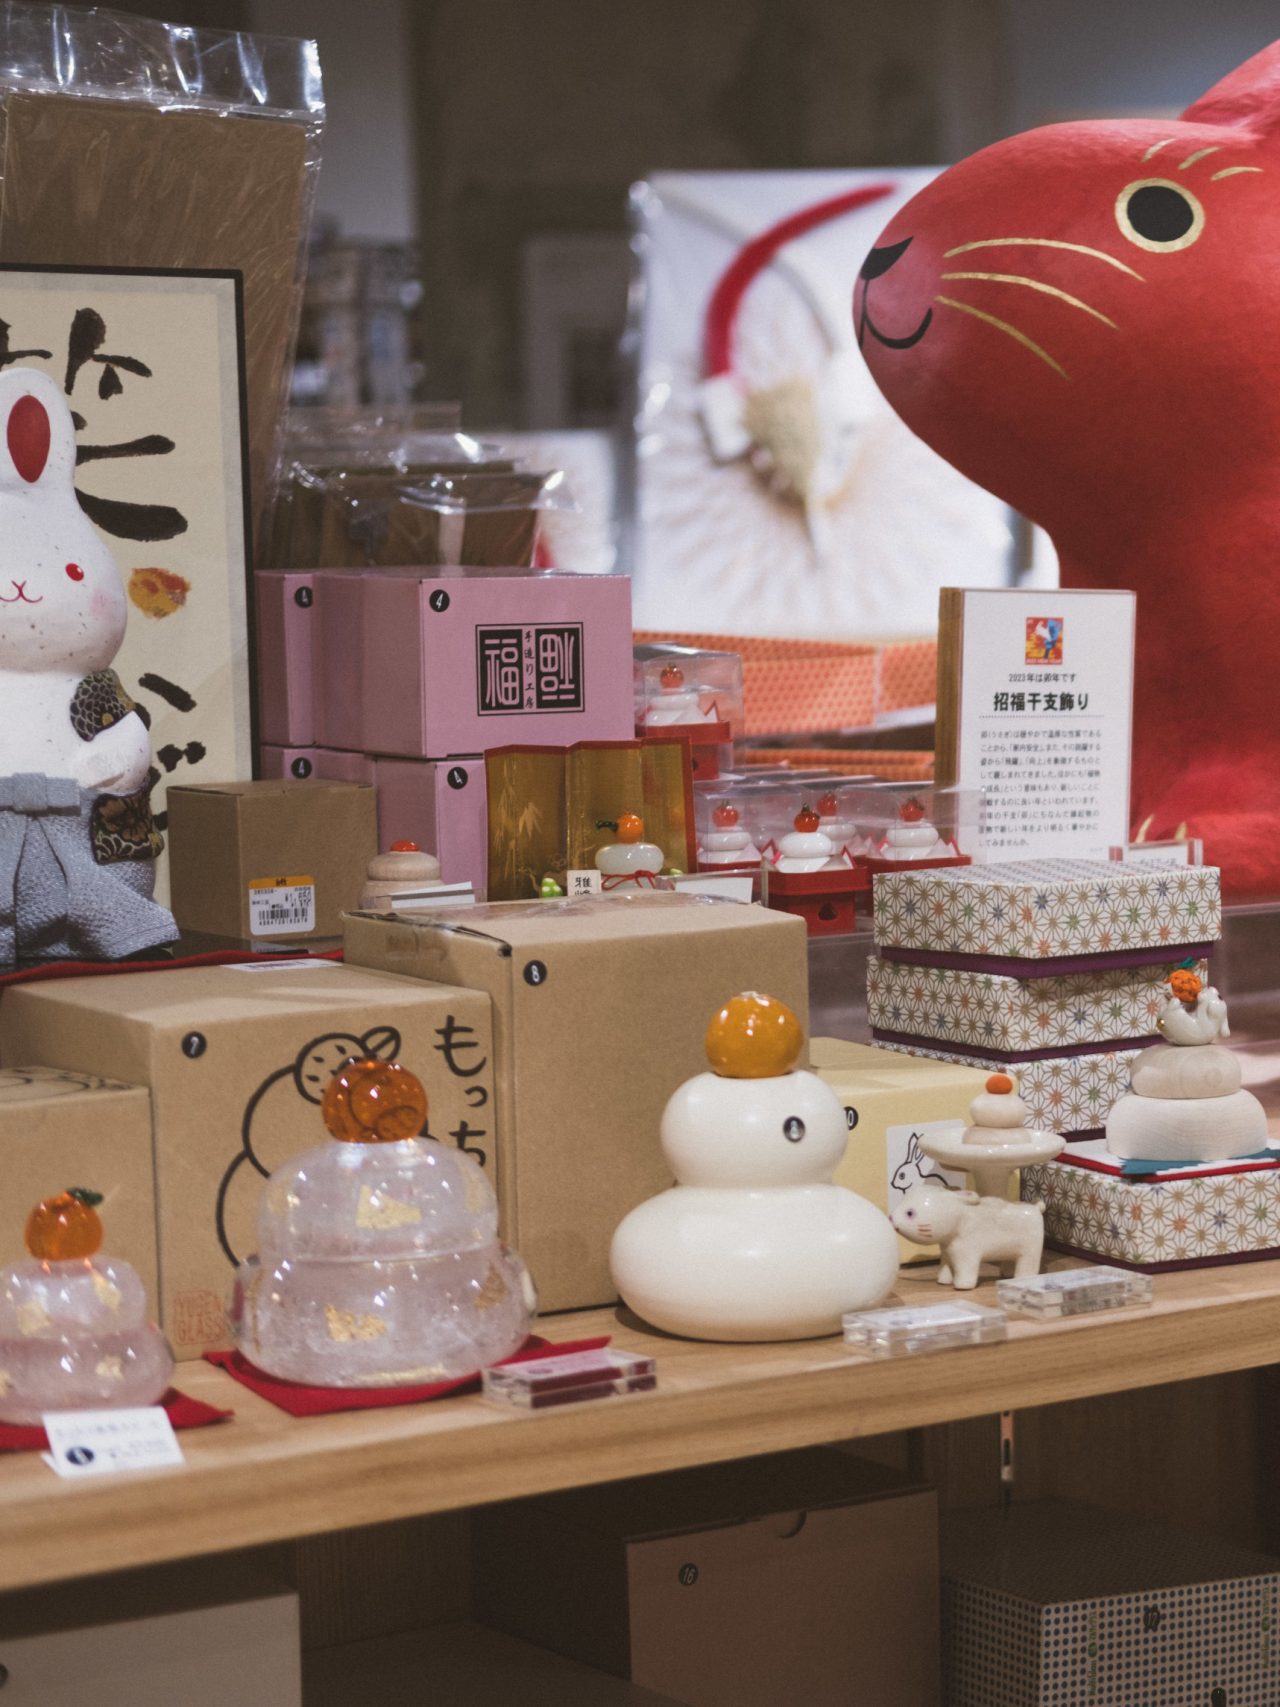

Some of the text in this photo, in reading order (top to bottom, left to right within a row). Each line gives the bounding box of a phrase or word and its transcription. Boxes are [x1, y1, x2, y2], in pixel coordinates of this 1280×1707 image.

[436, 594, 443, 609] 4
[484, 638, 520, 707] 福
[993, 692, 1090, 712] 招福干支飾り
[684, 1567, 696, 1585] 16
